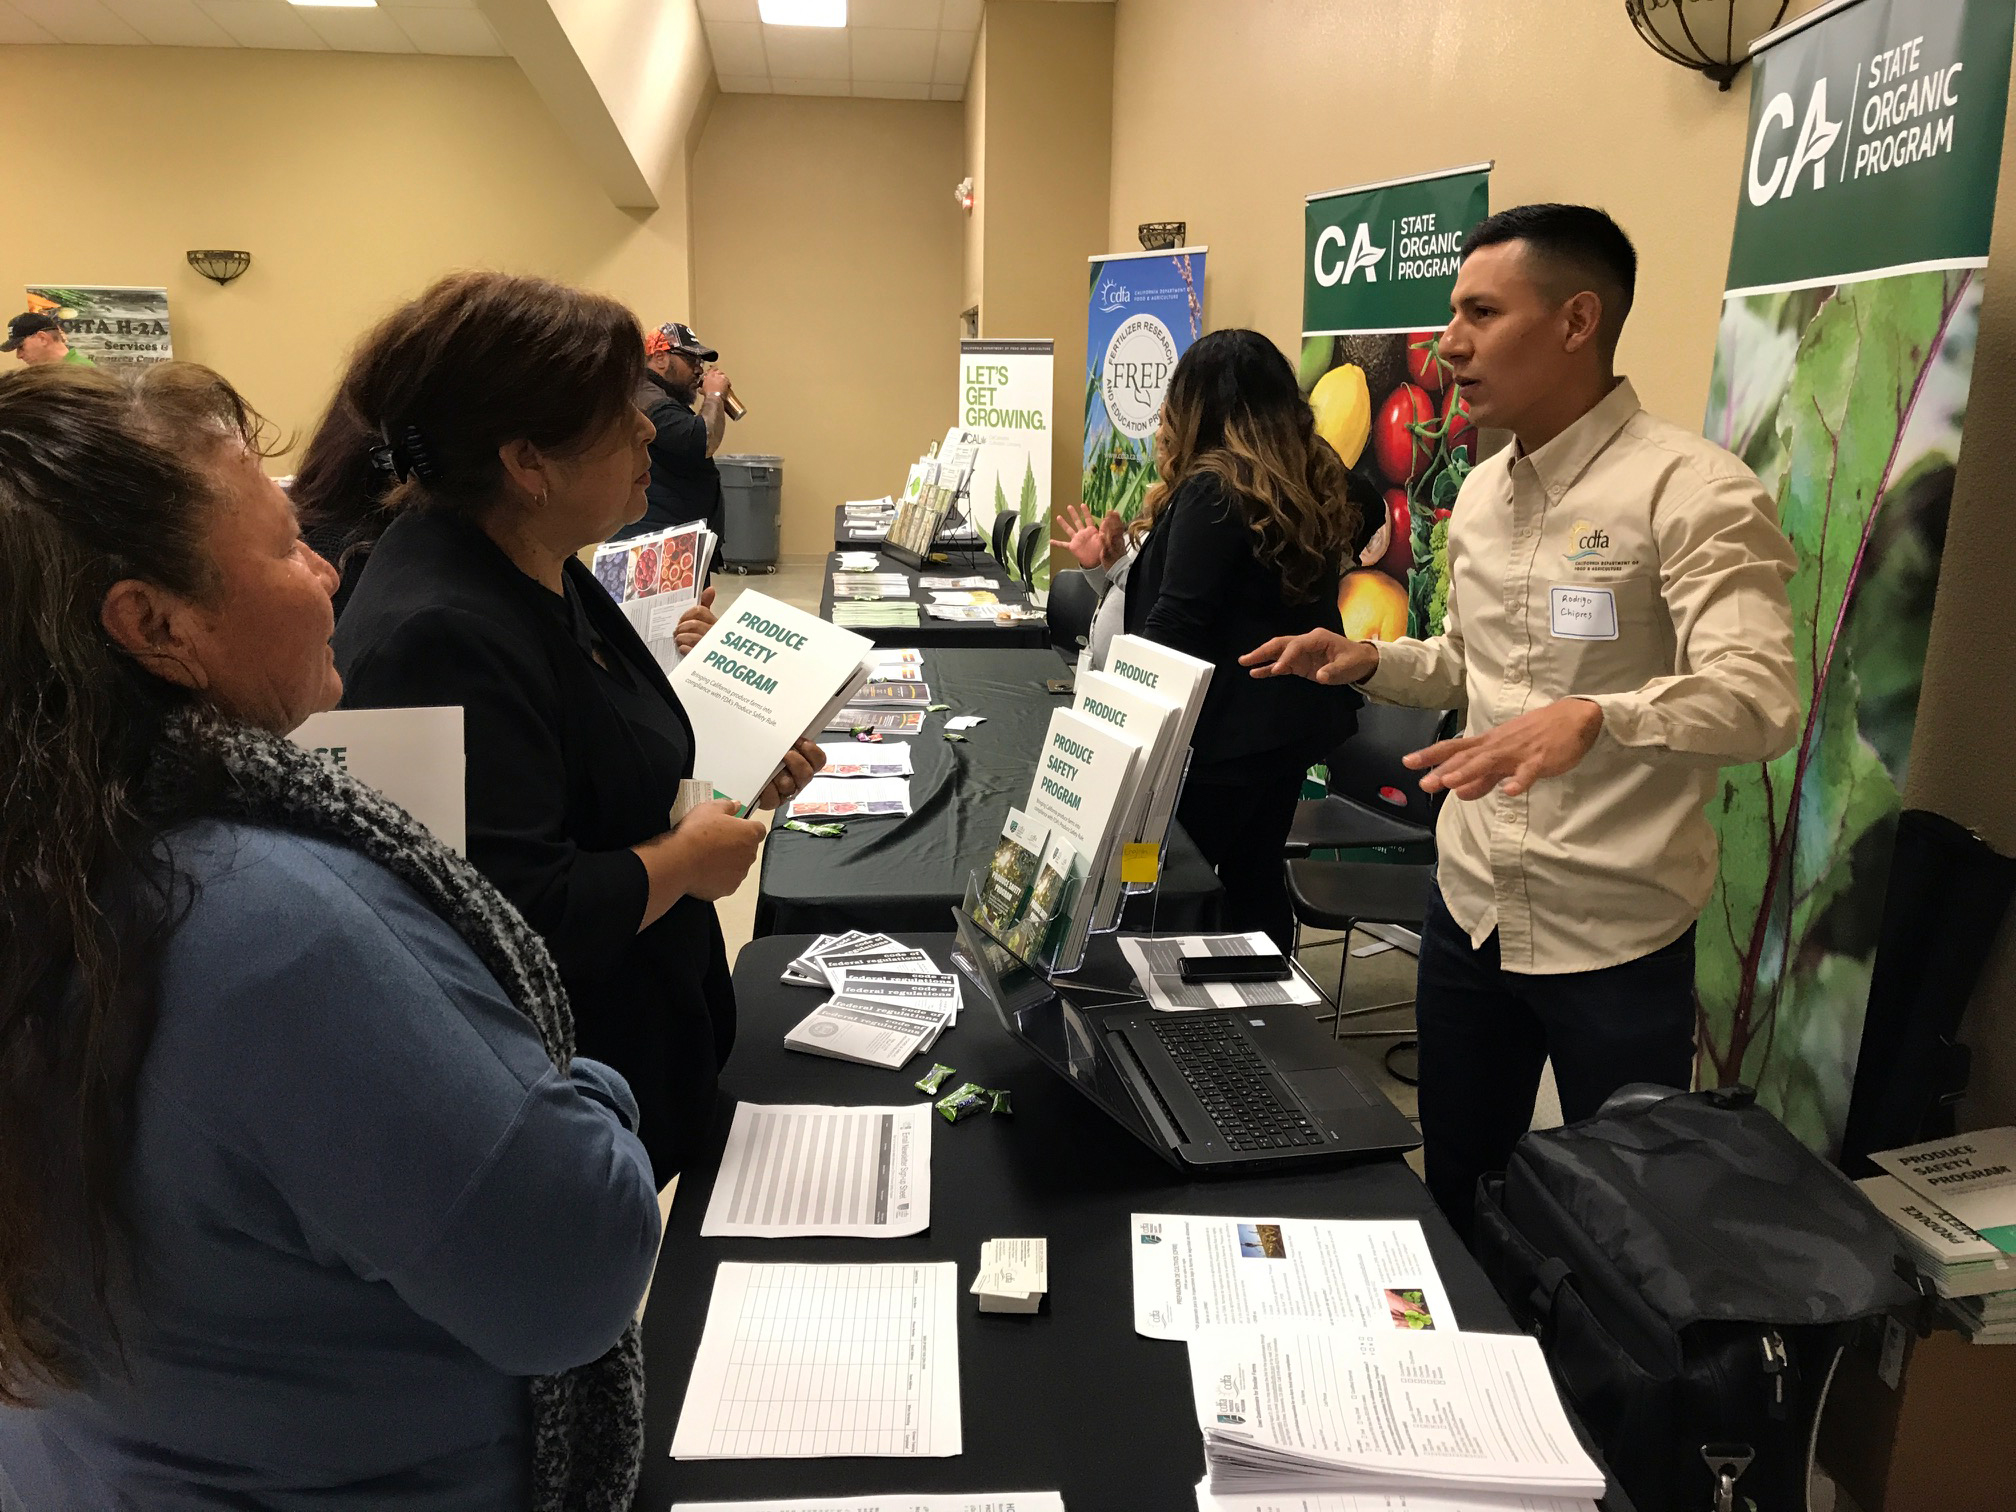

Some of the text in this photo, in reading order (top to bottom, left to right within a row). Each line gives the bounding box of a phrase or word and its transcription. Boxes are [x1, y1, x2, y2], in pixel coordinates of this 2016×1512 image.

[1868, 36, 1924, 89] STATE
[1863, 62, 1963, 135] ORGANIC
[1748, 77, 1843, 207] CA
[1854, 115, 1954, 180] PROGRAM
[1400, 214, 1436, 235] STATE
[1314, 222, 1386, 287] CA
[1400, 231, 1463, 259] ORGANIC
[1398, 256, 1461, 280] PROGRAM
[1110, 286, 1131, 303] cdfa
[116, 319, 168, 336] H-2A
[104, 341, 158, 352] Services
[1108, 321, 1174, 366] FERTILIZER RESEARCH
[966, 365, 1009, 386] LET'S
[1113, 362, 1168, 389] FREP
[966, 386, 997, 406] GET
[1106, 378, 1114, 401] AND
[1110, 402, 1148, 432] EDUCATION
[965, 407, 1046, 430] GROWING.
[1579, 529, 1610, 549] cdfa
[1561, 594, 1593, 608] Rodrigo
[736, 611, 809, 652] PRODUCE
[720, 631, 779, 665] SAFETY
[702, 650, 779, 695] PROGRAM
[1113, 659, 1160, 690] PRODUCE
[685, 677, 710, 696] compliance
[710, 690, 722, 700] with
[734, 701, 753, 716] Produce
[752, 709, 767, 724] Safety
[690, 670, 773, 715] Bringing California produce farms into
[1082, 695, 1128, 729] PRODUCE
[1053, 732, 1095, 766] PRODUCE
[1046, 754, 1079, 782] SAFETY
[1040, 775, 1082, 811] PROGRAM
[854, 940, 873, 948] code
[828, 955, 923, 968] federal regulations
[845, 986, 952, 998] federal regulations
[820, 1010, 921, 1035] federal regulations
[835, 1001, 939, 1022] federal regulations
[885, 1018, 909, 1027] code
[901, 1006, 944, 1018] code of
[900, 1144, 910, 1167] Newsletter
[1898, 1144, 1978, 1166] PRODUCE
[1912, 1157, 1973, 1176] SAFETY
[1927, 1164, 2012, 1187] PROGRAM
[899, 1185, 908, 1200] Sheet
[1901, 1205, 1965, 1245] PRODUCE
[1220, 1375, 1232, 1390] cdfa
[1216, 1399, 1227, 1412] cdfa
